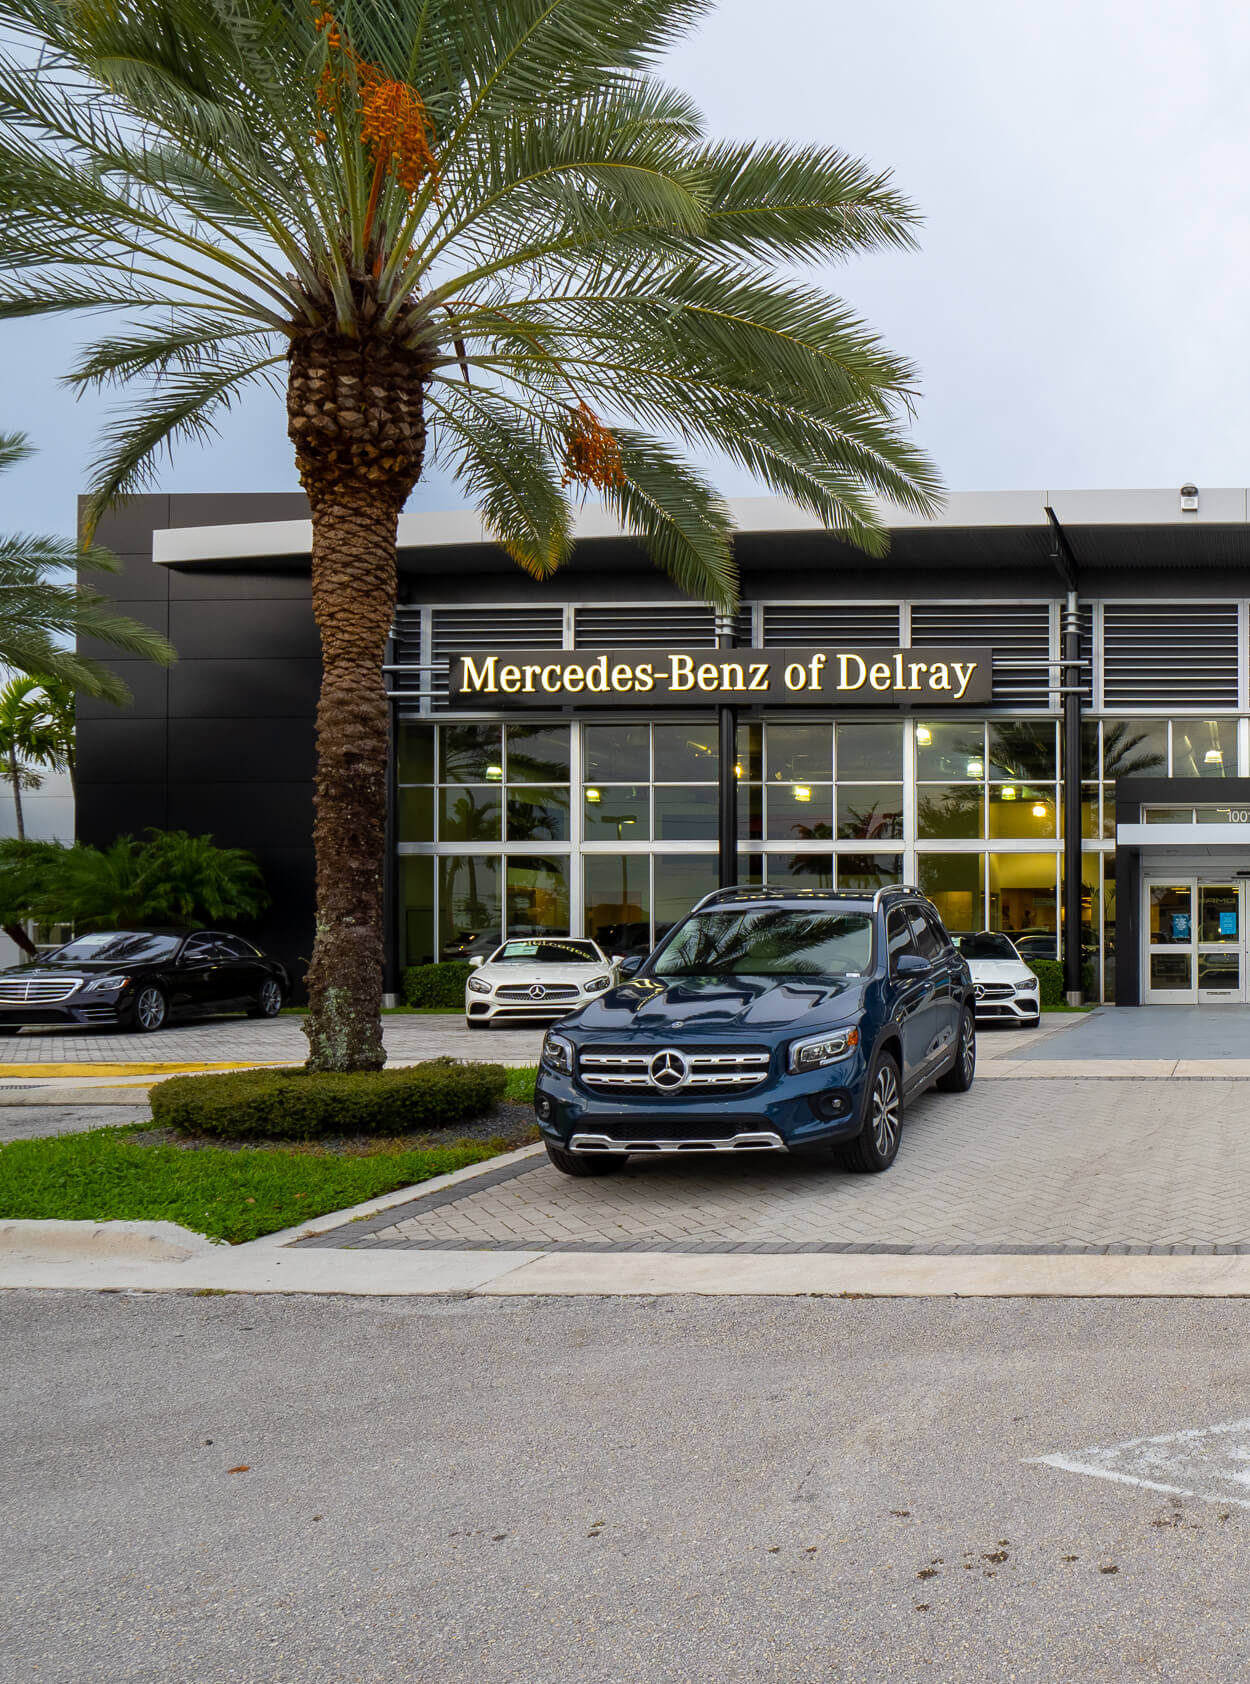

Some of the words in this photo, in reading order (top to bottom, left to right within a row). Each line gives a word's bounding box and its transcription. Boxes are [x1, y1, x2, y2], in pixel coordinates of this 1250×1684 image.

[459, 654, 770, 693] Mercedes-Benz
[784, 653, 826, 691] of
[836, 653, 977, 699] Delray
